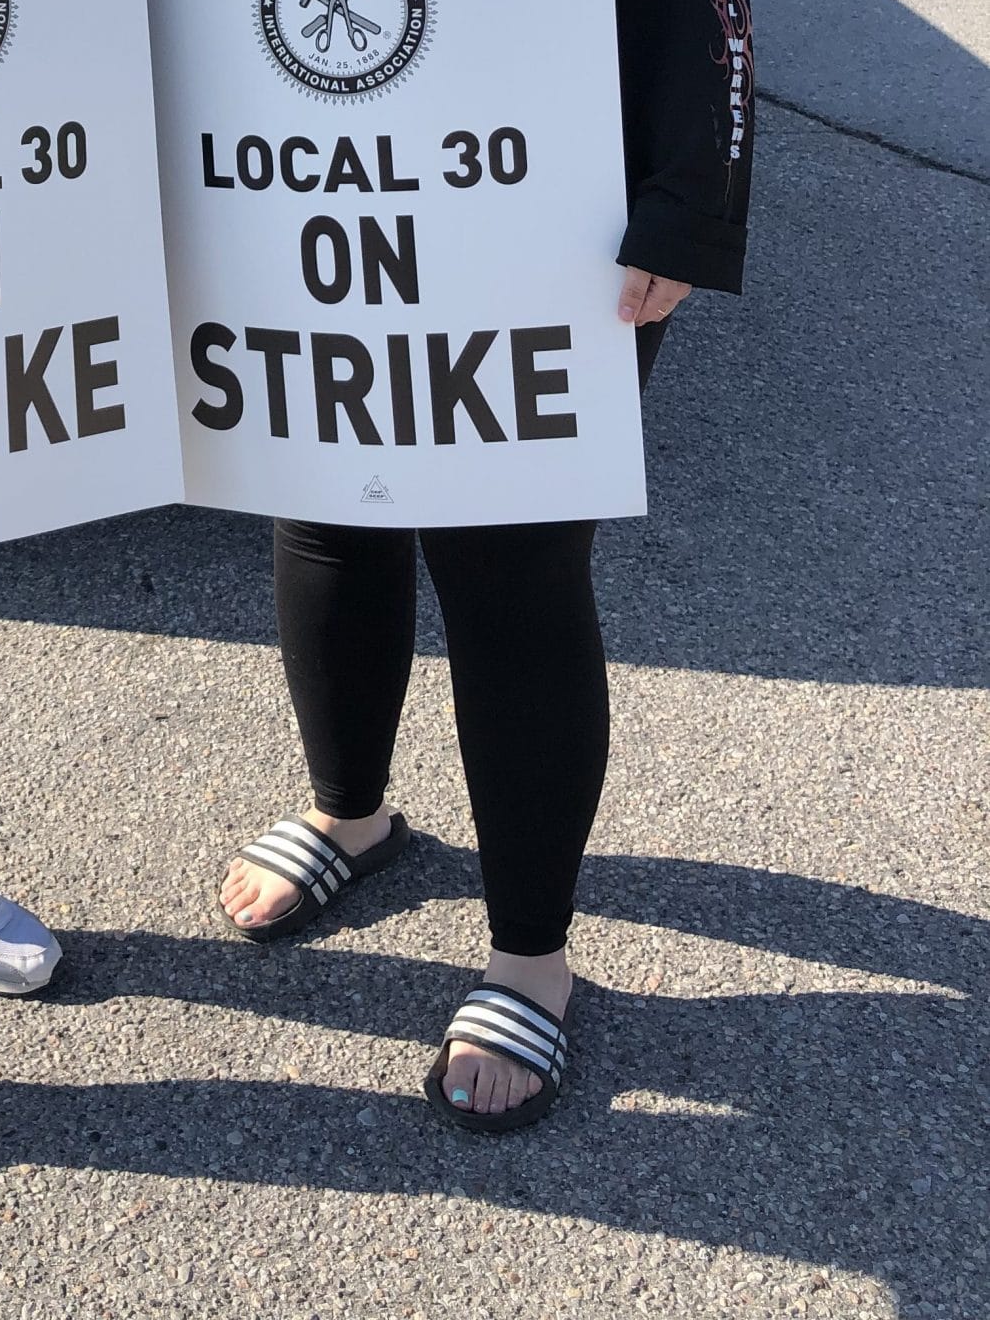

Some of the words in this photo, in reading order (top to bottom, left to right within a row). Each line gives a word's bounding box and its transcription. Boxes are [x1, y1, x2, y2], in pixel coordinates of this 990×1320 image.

[263, 15, 350, 92] INTERNATIONAL
[356, 8, 423, 90] ASSOCIATION
[308, 52, 332, 68] JAN.
[336, 61, 353, 70] 25,
[357, 49, 380, 66] 1888
[728, 38, 744, 159] WORKERS
[20, 121, 87, 185] 30
[200, 132, 420, 193] LOCAL
[441, 126, 528, 189] 30
[300, 214, 420, 305] ON
[190, 321, 578, 446] STRIKE
